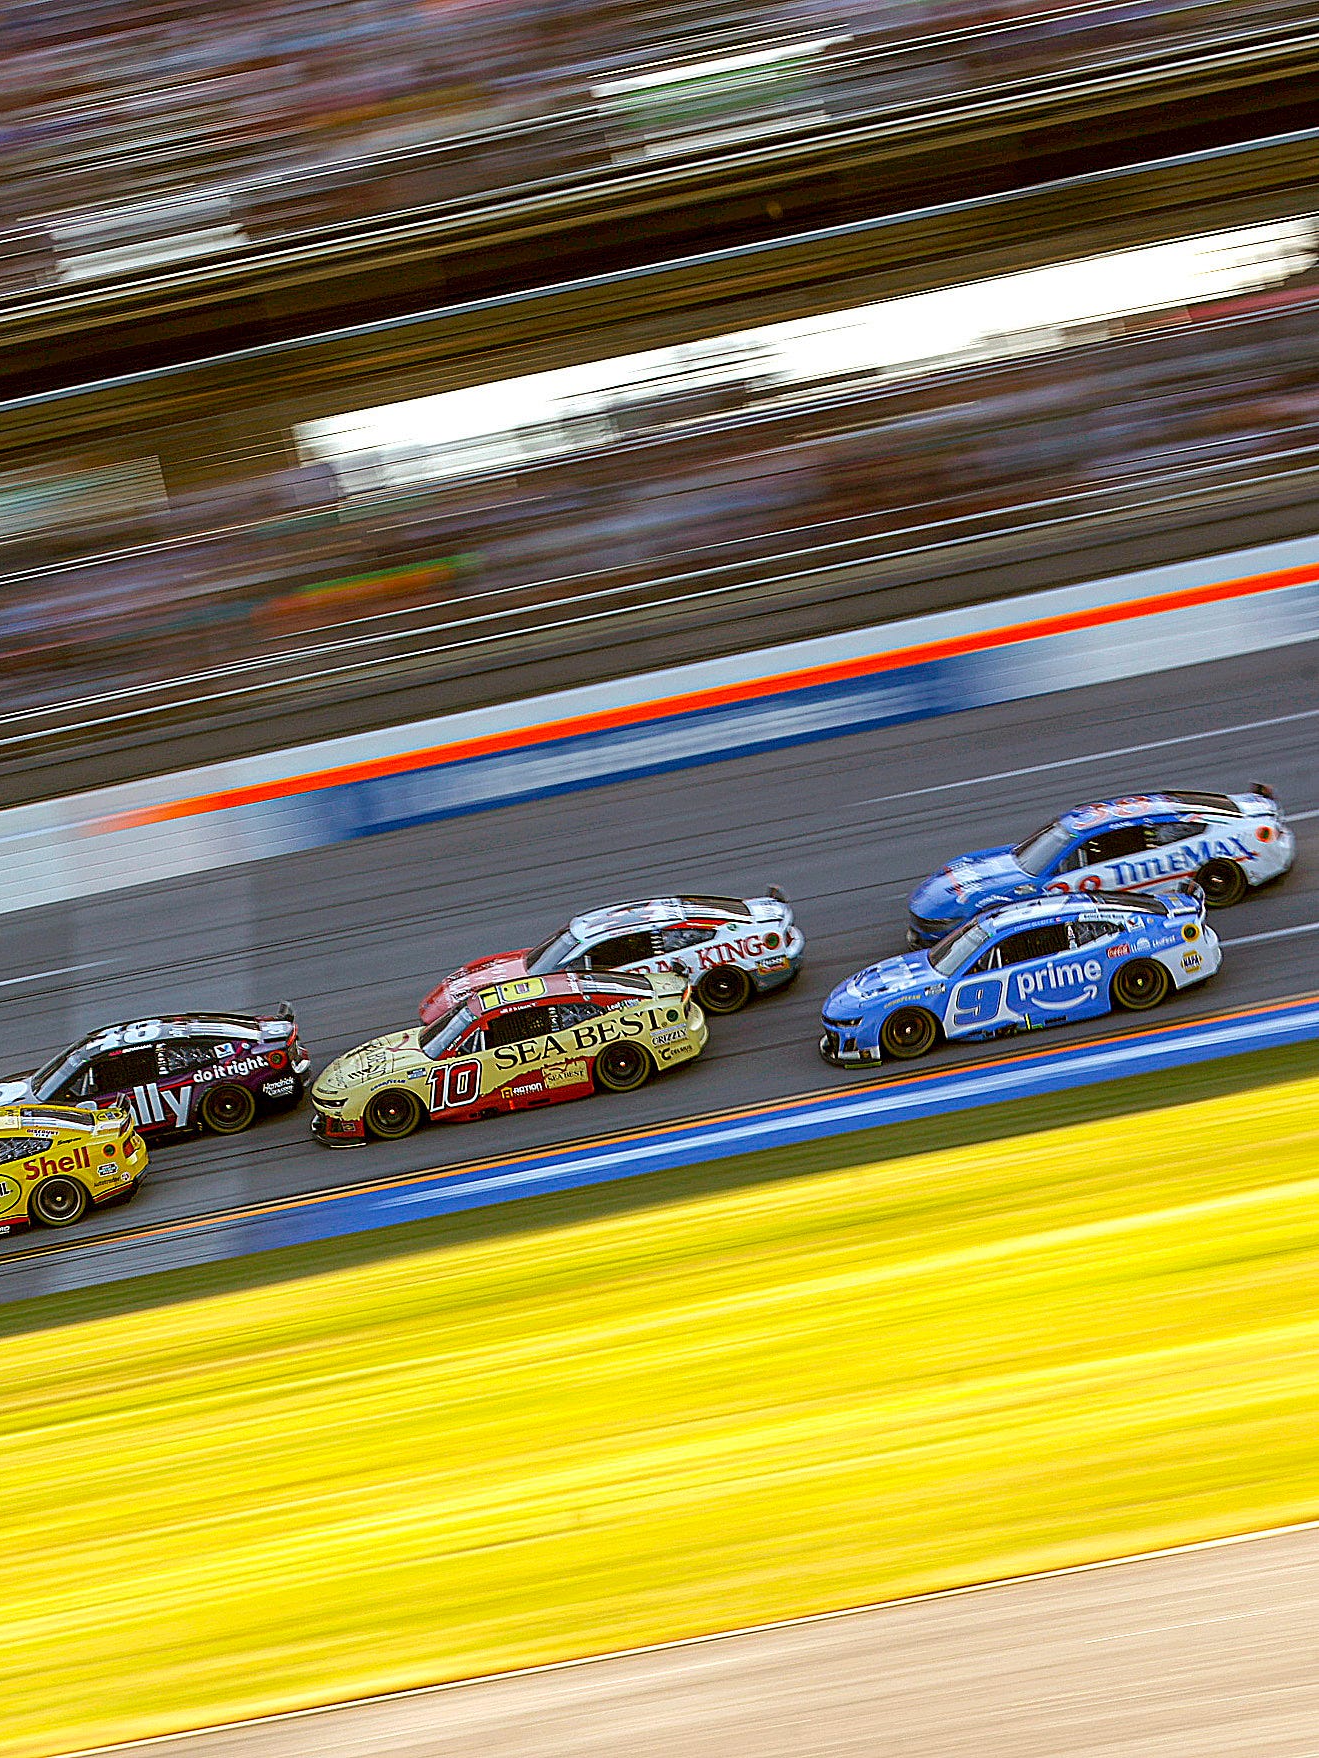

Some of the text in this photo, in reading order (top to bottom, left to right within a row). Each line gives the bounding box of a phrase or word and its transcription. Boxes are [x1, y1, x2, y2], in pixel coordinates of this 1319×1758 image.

[695, 935, 767, 970] KING
[477, 977, 547, 1012] 10
[1016, 959, 1102, 1000] prime
[953, 979, 1003, 1026] 9
[85, 1019, 162, 1051] 48
[493, 1007, 664, 1071] SEA BEST
[193, 1070, 214, 1083] do
[214, 1064, 226, 1079] it
[426, 1058, 481, 1113] 10
[547, 1070, 584, 1082] SEA BEST
[23, 1146, 90, 1180] Shell
